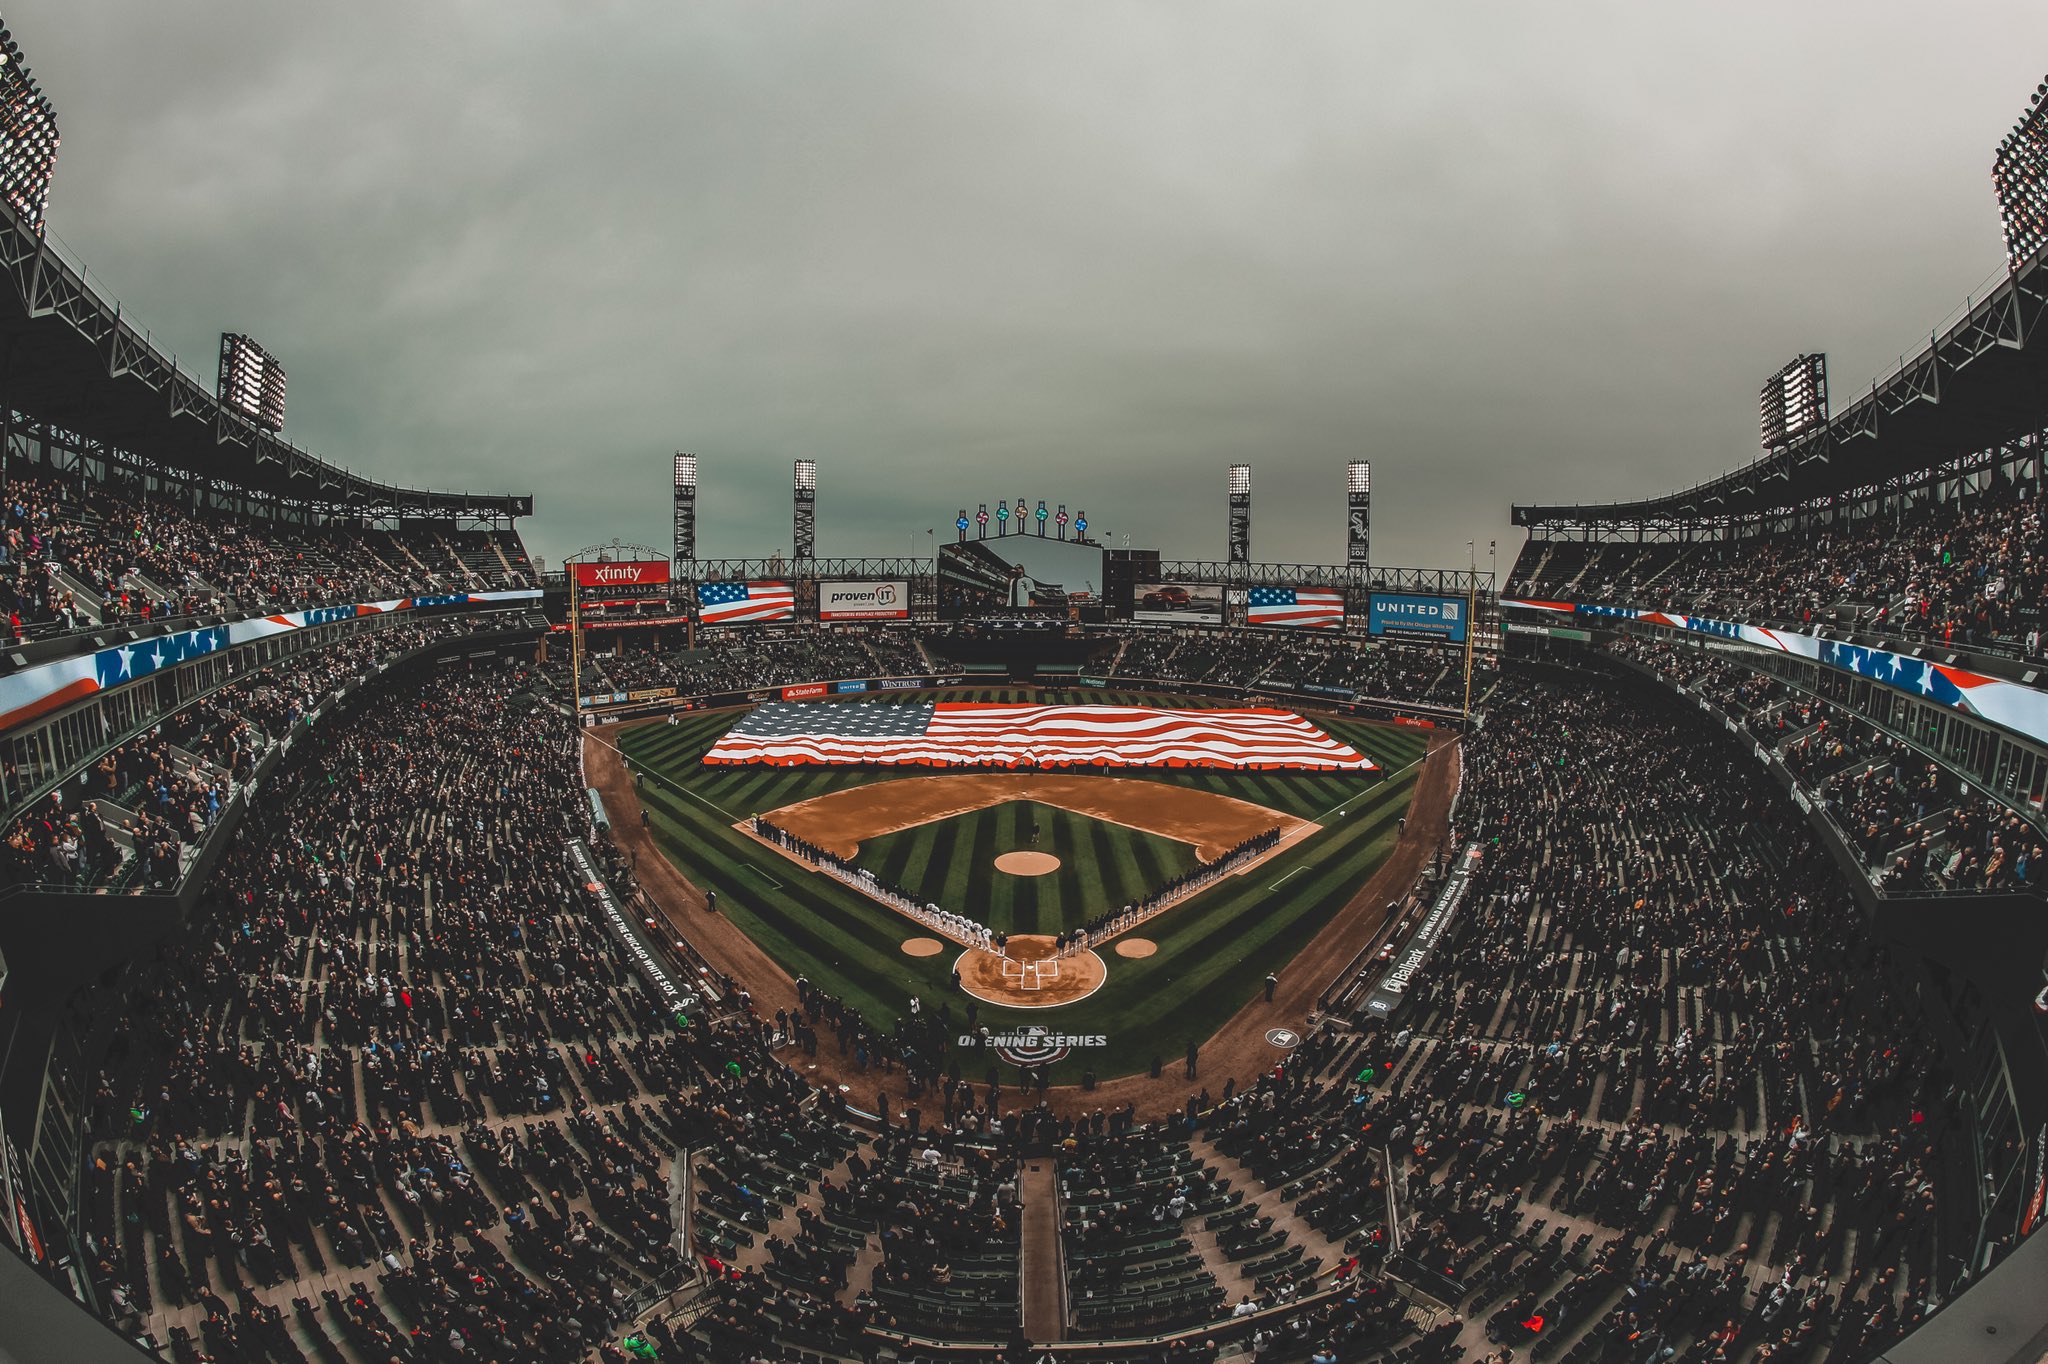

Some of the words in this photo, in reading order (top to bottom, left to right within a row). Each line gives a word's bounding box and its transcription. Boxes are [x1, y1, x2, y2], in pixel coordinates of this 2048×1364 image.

[595, 565, 642, 583] xfinity
[831, 592, 875, 603] proven
[880, 590, 892, 600] IT
[1376, 602, 1439, 615] UNITED
[1508, 624, 1536, 634] Huntington
[1536, 626, 1549, 634] Bank
[882, 680, 921, 688] WINTRUST
[602, 716, 619, 724] Modelo
[1418, 909, 1442, 940] DOWNLOAD
[602, 900, 617, 914] HOME
[616, 921, 630, 934] THE
[623, 931, 648, 960] CHICAGO
[643, 957, 665, 981] WHITE
[658, 979, 678, 996] SOX
[1392, 948, 1426, 983] Ballpark
[1042, 1035, 1108, 1047] SERIES
